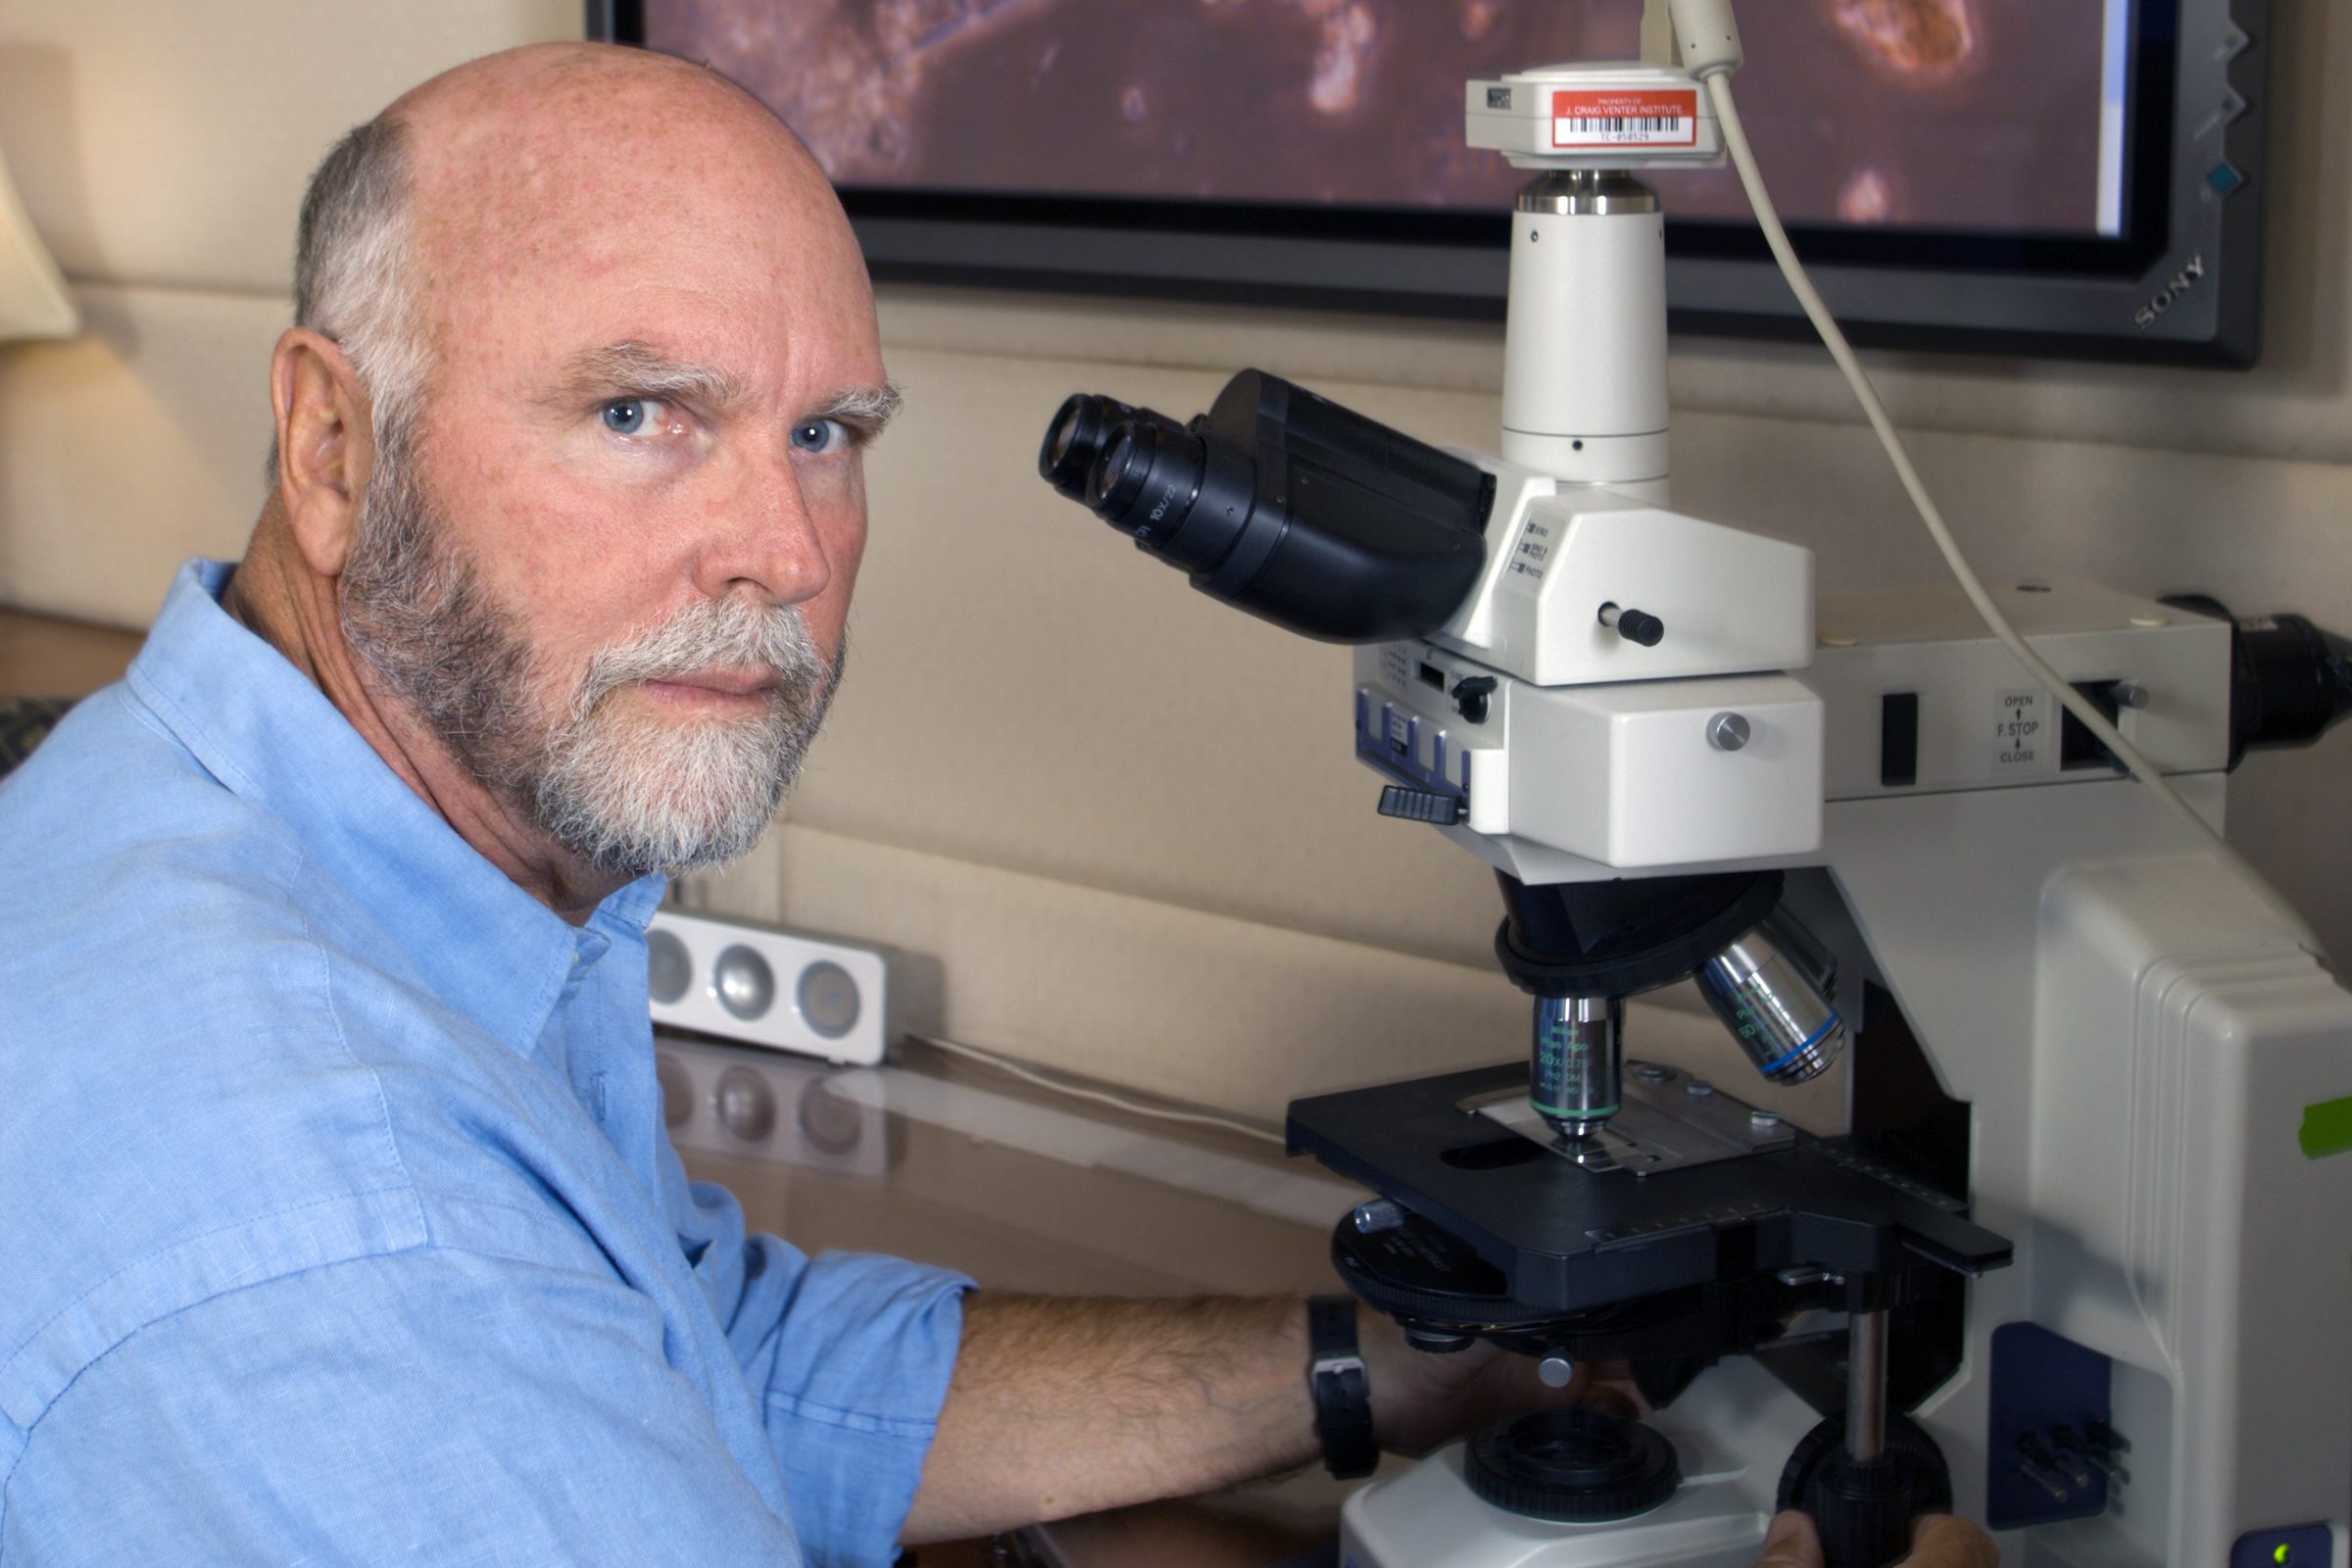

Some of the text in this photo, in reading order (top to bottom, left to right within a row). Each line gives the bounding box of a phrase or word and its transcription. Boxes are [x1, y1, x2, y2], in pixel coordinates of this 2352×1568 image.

[1565, 105, 1684, 116] J. CRAIG VENTER INSTITUTE
[2134, 254, 2204, 329] SONY
[1525, 565, 1544, 579] PHOTO
[2004, 695, 2034, 708] OPEN
[2000, 751, 2034, 763] CLOSE
[1541, 1037, 1589, 1053] Plan Apo
